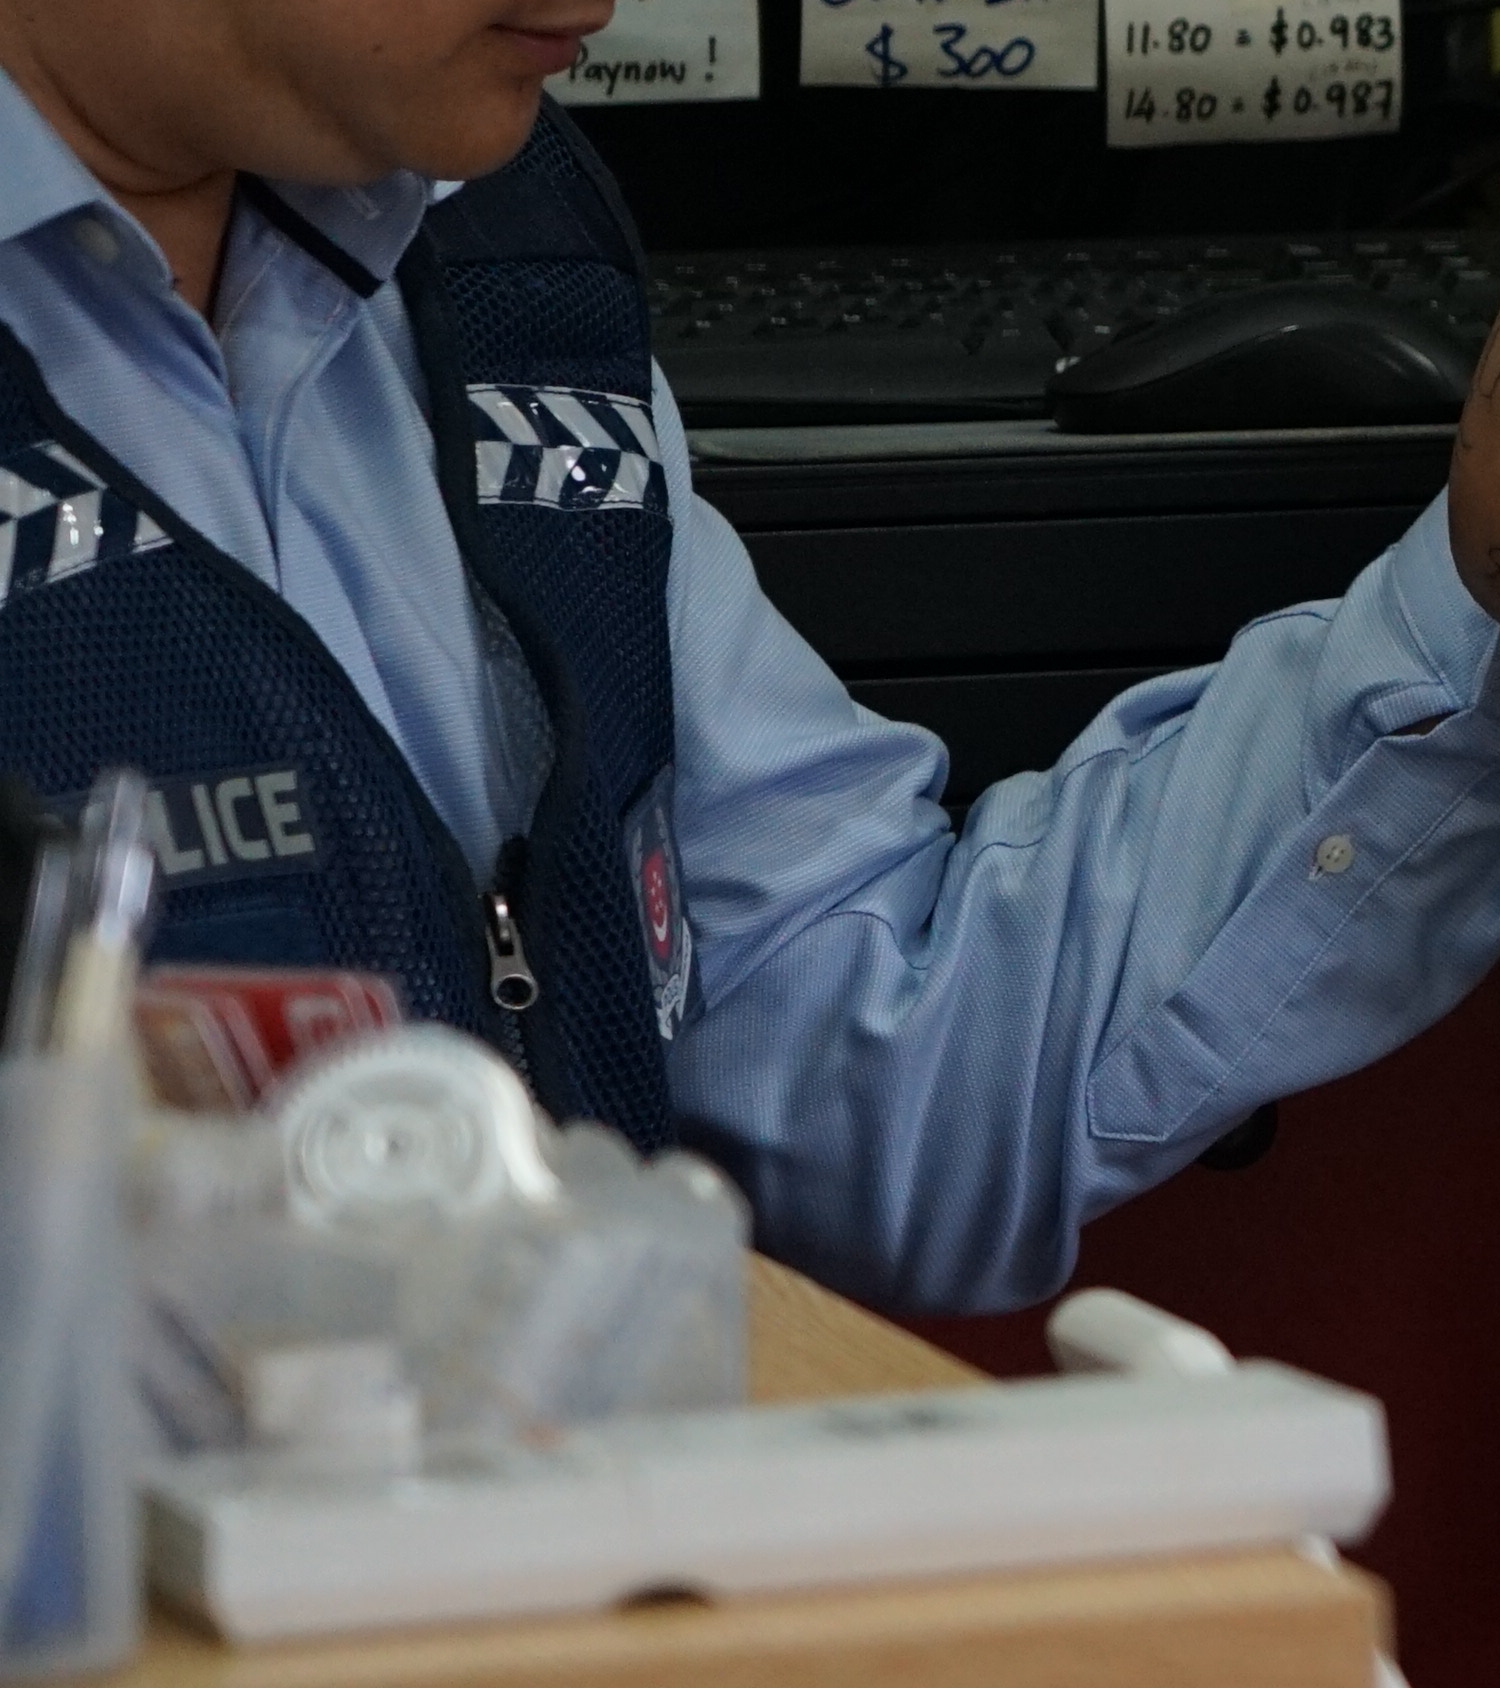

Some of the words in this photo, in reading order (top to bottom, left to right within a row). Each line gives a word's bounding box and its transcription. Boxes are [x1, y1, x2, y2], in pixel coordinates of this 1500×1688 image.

[933, 22, 1037, 79] 300
[1127, 17, 1212, 54] 11.80
[1125, 86, 1218, 124] 14.80
[147, 770, 316, 875] LICE
